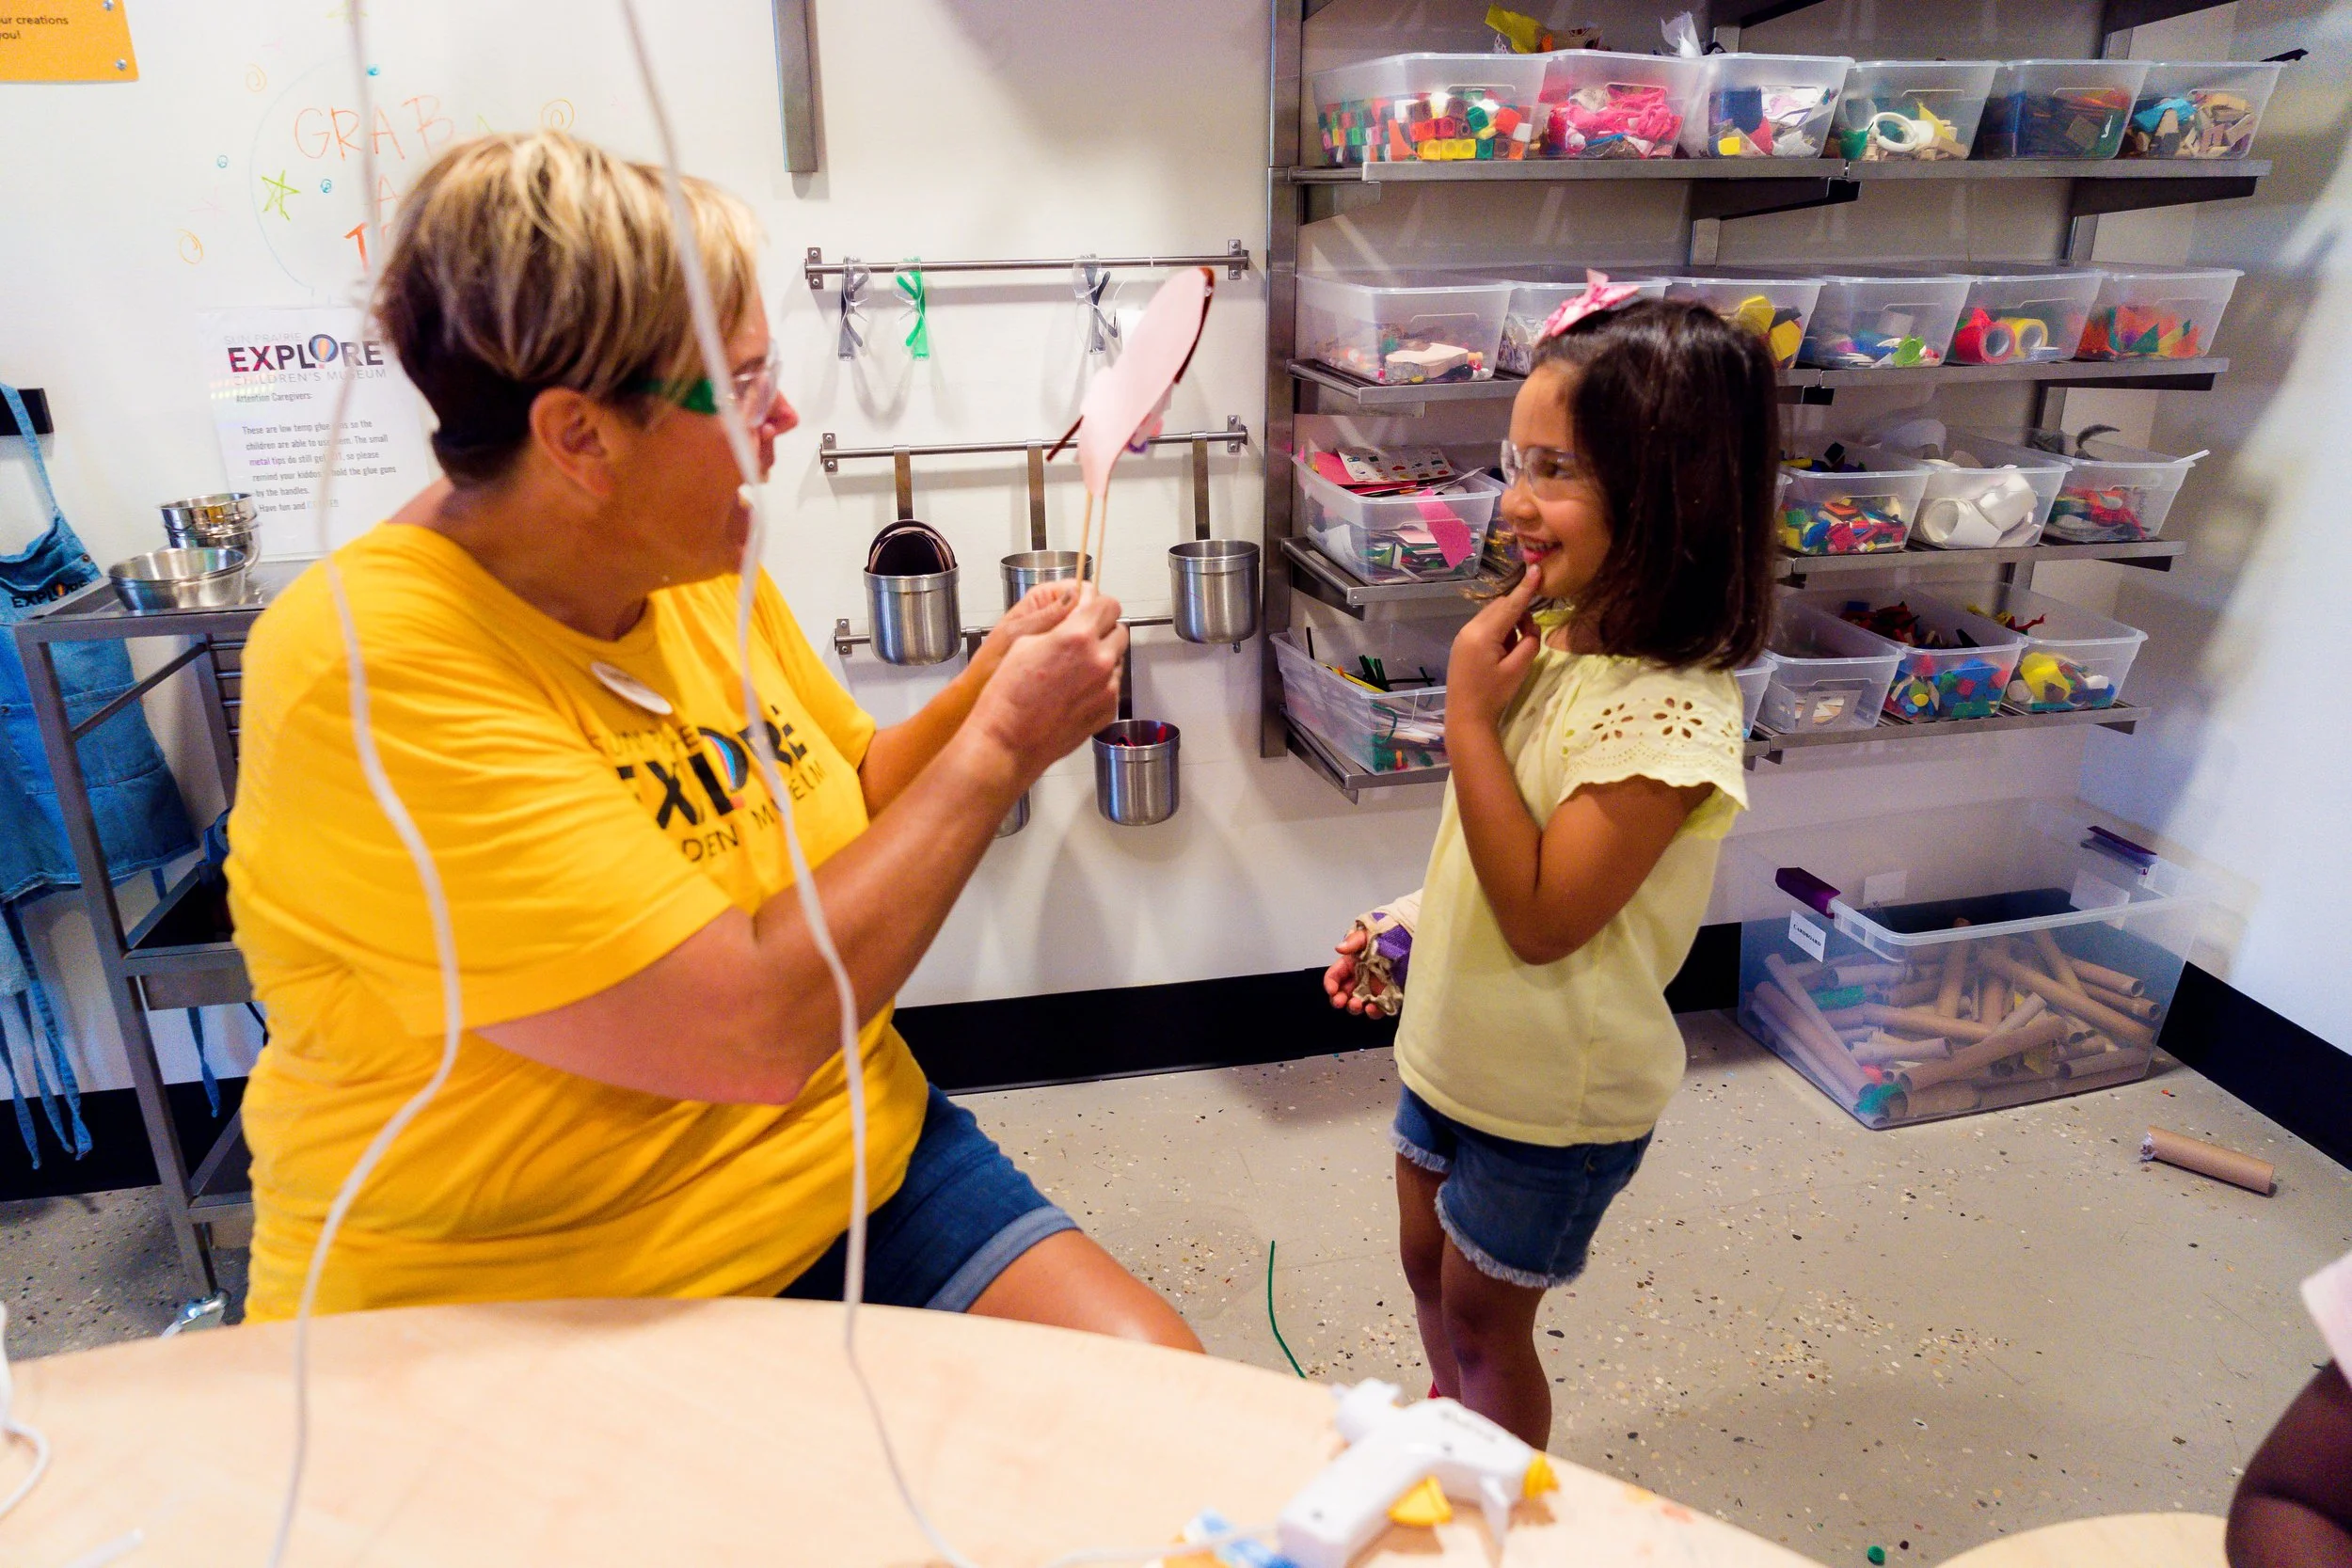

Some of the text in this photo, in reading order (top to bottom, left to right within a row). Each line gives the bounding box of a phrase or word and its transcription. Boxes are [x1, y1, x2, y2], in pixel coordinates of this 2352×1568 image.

[16, 15, 69, 25] creations
[0, 30, 22, 40] ou!
[294, 95, 454, 161] GRAB
[223, 332, 302, 345] SUN PRAIRIE
[227, 334, 385, 373] EXPLORE
[234, 371, 322, 386] CHILDREN'S
[236, 393, 270, 403] Attention
[242, 426, 263, 435] These
[279, 424, 292, 433] low
[294, 424, 312, 433] temp
[360, 420, 373, 428] the
[246, 441, 276, 451] children
[291, 439, 307, 448] able
[354, 436, 367, 444] The
[369, 434, 388, 444] small
[249, 457, 270, 467] metal
[271, 456, 286, 466] tips
[357, 451, 380, 461] please
[252, 472, 278, 482] remind
[279, 472, 295, 481] your
[349, 467, 360, 476] the
[362, 466, 377, 476] glue
[380, 466, 396, 476] guns
[266, 488, 278, 497] the
[279, 486, 310, 496] handles.
[259, 503, 278, 513] Have
[293, 501, 306, 510] and
[751, 760, 825, 831] MEUM
[1793, 924, 1821, 947] CARDBOARD
